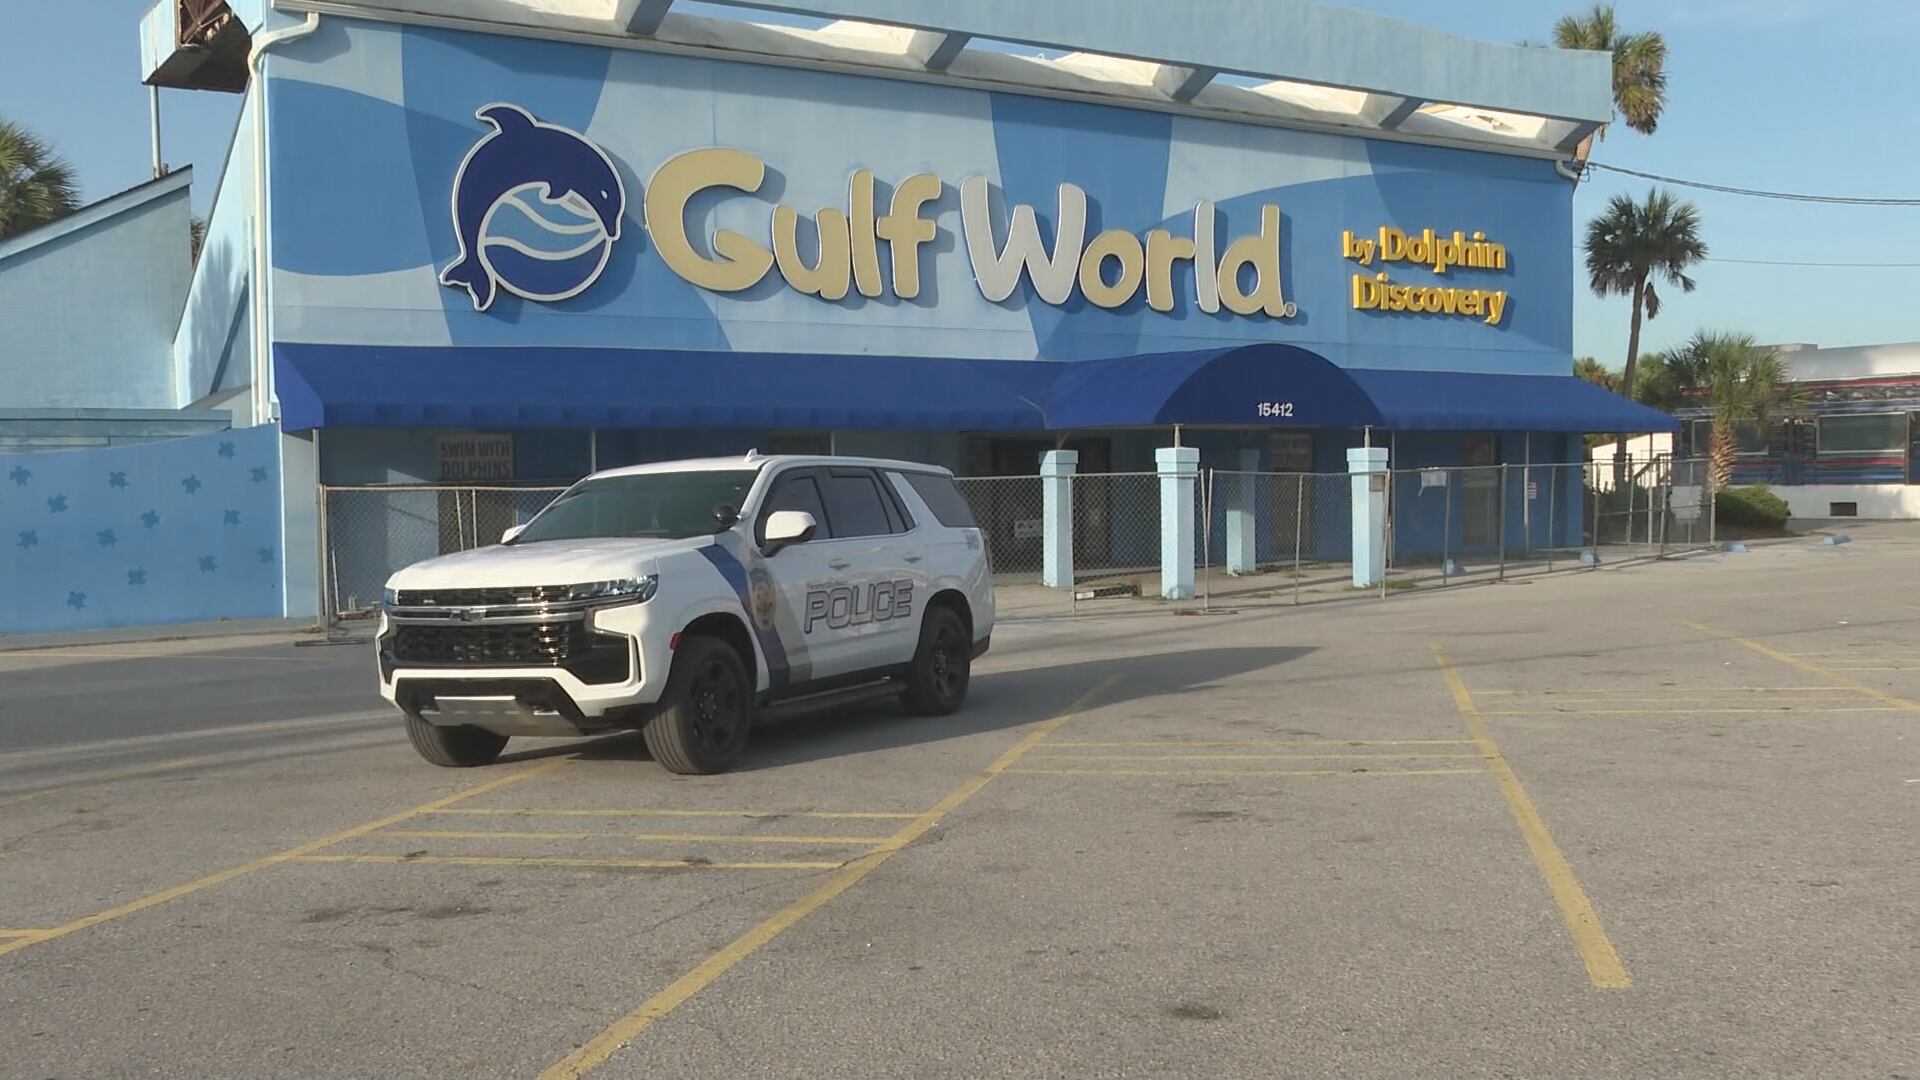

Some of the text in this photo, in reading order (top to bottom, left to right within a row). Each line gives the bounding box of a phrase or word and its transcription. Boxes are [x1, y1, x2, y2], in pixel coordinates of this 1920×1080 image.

[645, 147, 1286, 317] Gulf World
[1342, 225, 1507, 273] by Dolphin
[1352, 271, 1507, 325] Discovery
[1257, 402, 1293, 418] 15412
[441, 442, 509, 457] SWIM WITH
[441, 460, 511, 478] DOLPHINS
[803, 578, 914, 635] POLICE
